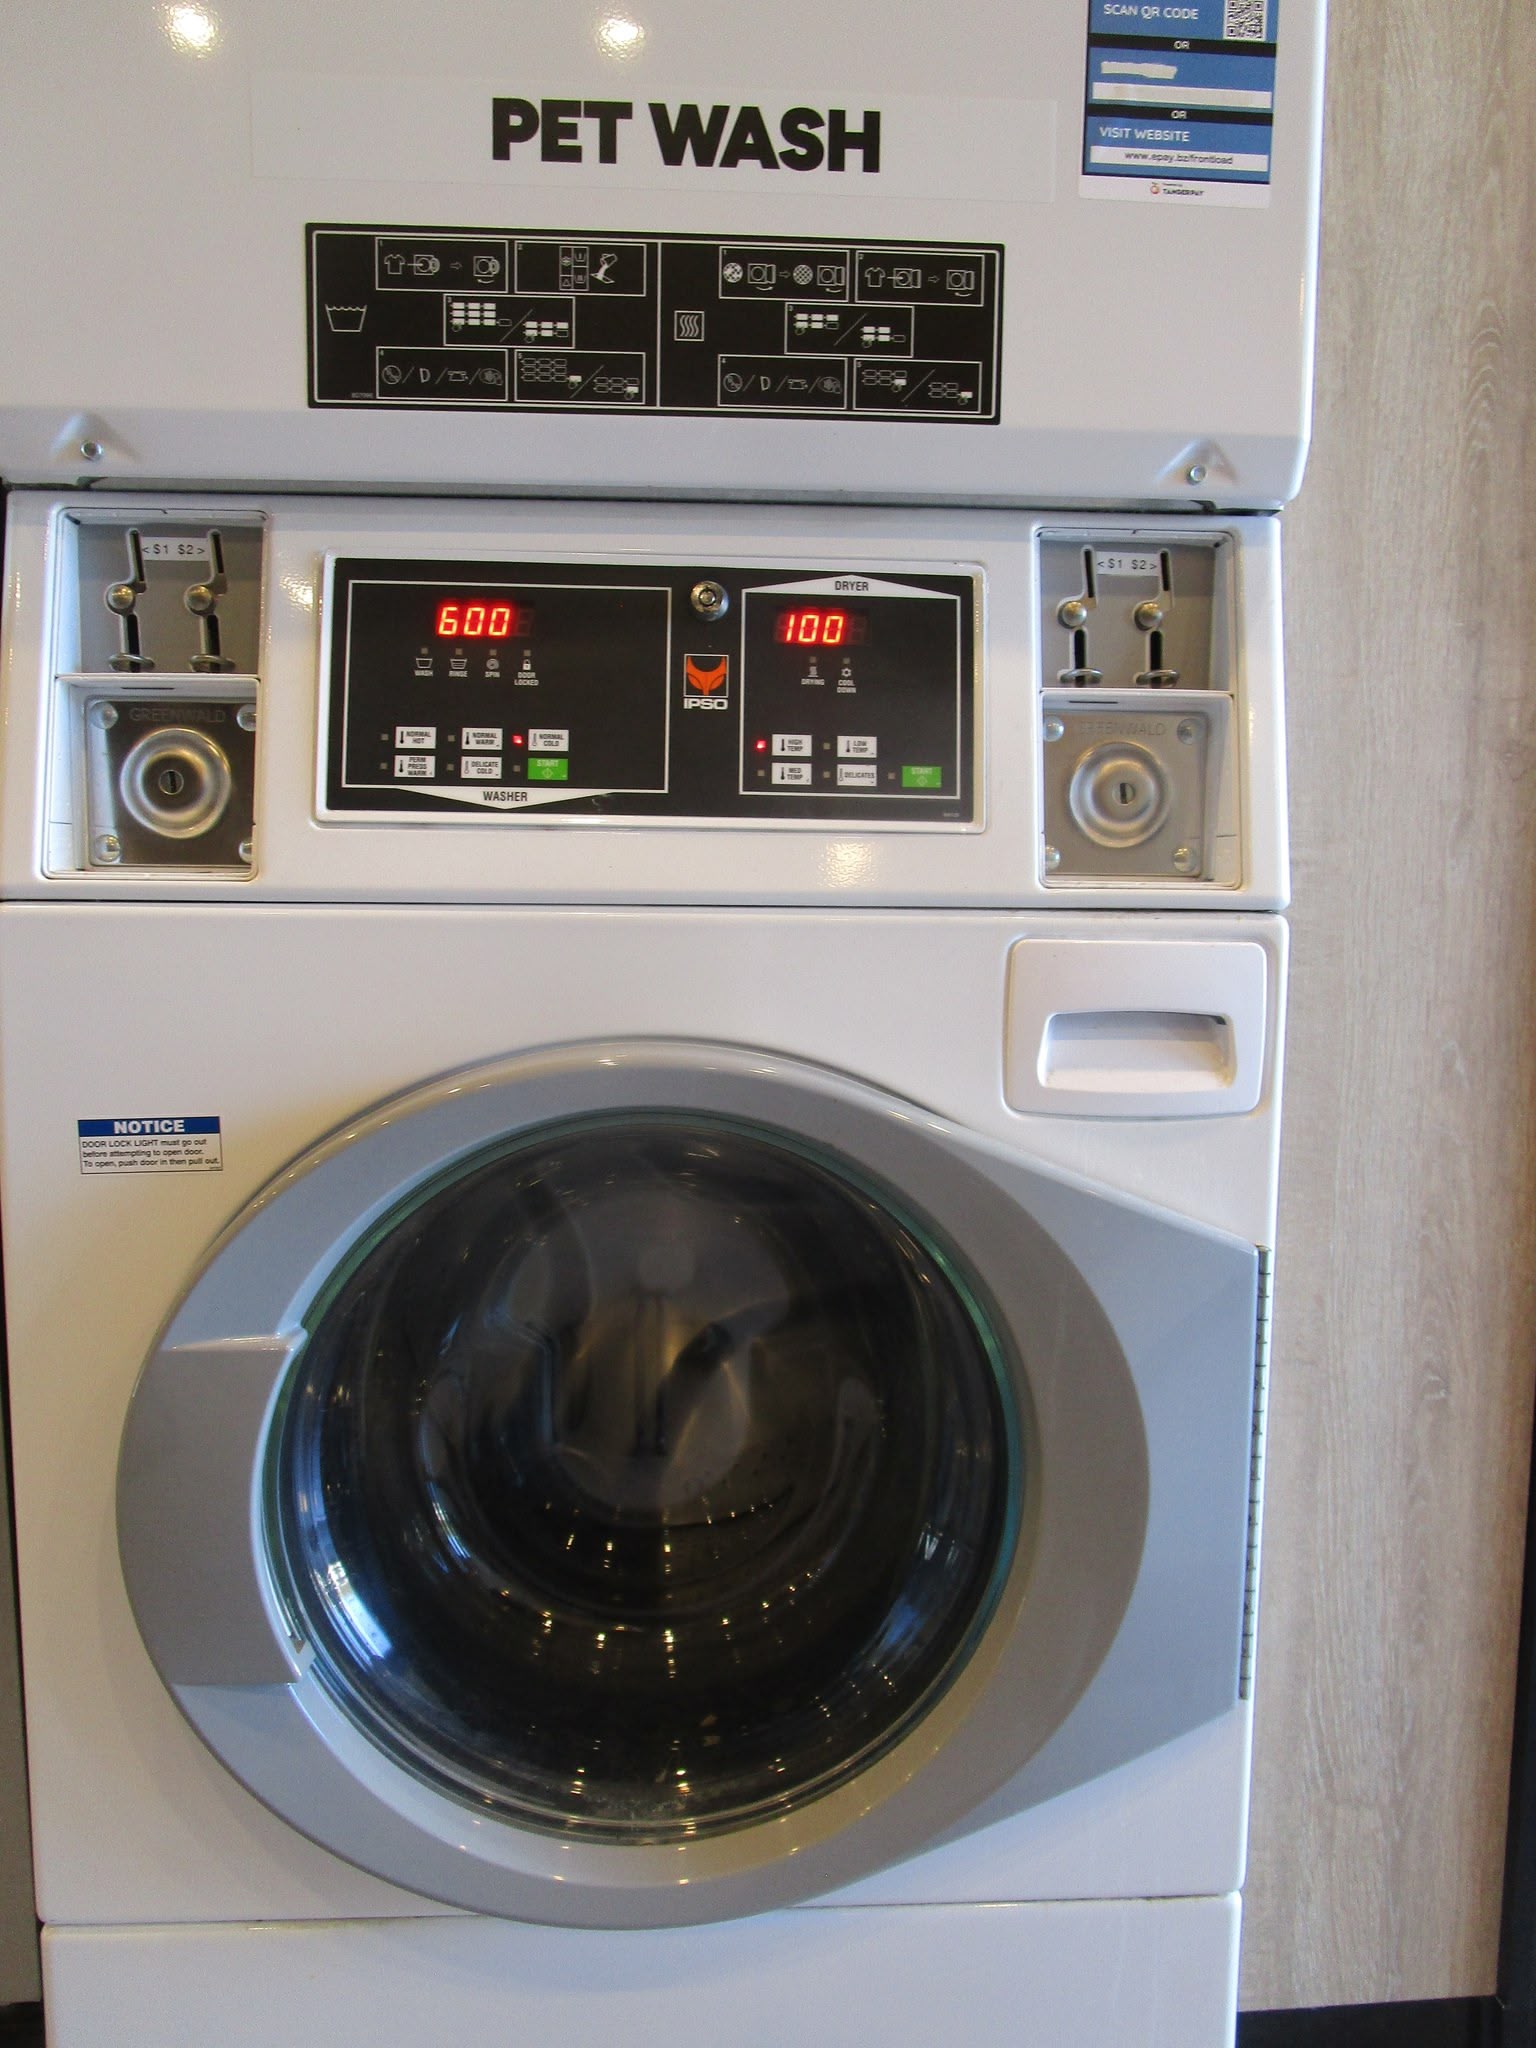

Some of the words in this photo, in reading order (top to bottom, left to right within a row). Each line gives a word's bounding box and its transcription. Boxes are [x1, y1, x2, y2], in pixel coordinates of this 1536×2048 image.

[1104, 4, 1138, 16] SCAN
[1141, 6, 1160, 19] QR
[1163, 8, 1199, 20] CODE
[1173, 41, 1190, 50] OR
[1171, 110, 1188, 119] OR
[492, 97, 633, 164] PET
[648, 102, 881, 173] WASH
[1100, 126, 1132, 139] VISIT
[1135, 129, 1190, 142] WEBSITE
[834, 580, 869, 592] DRYER
[438, 606, 511, 636] 600
[786, 614, 844, 644] 100
[517, 671, 536, 679] DOOR
[684, 697, 728, 710] IPSO
[536, 759, 559, 767] START
[844, 771, 875, 779] DELICATES
[911, 767, 932, 775] START
[483, 791, 528, 802] WASHER
[113, 1119, 185, 1134] NOTICE
[82, 1140, 107, 1148] DOOR
[134, 1139, 158, 1147] LIGHT
[194, 1138, 207, 1146] out
[110, 1150, 151, 1158] attempting
[118, 1159, 138, 1168] push
[188, 1158, 203, 1166] pull
